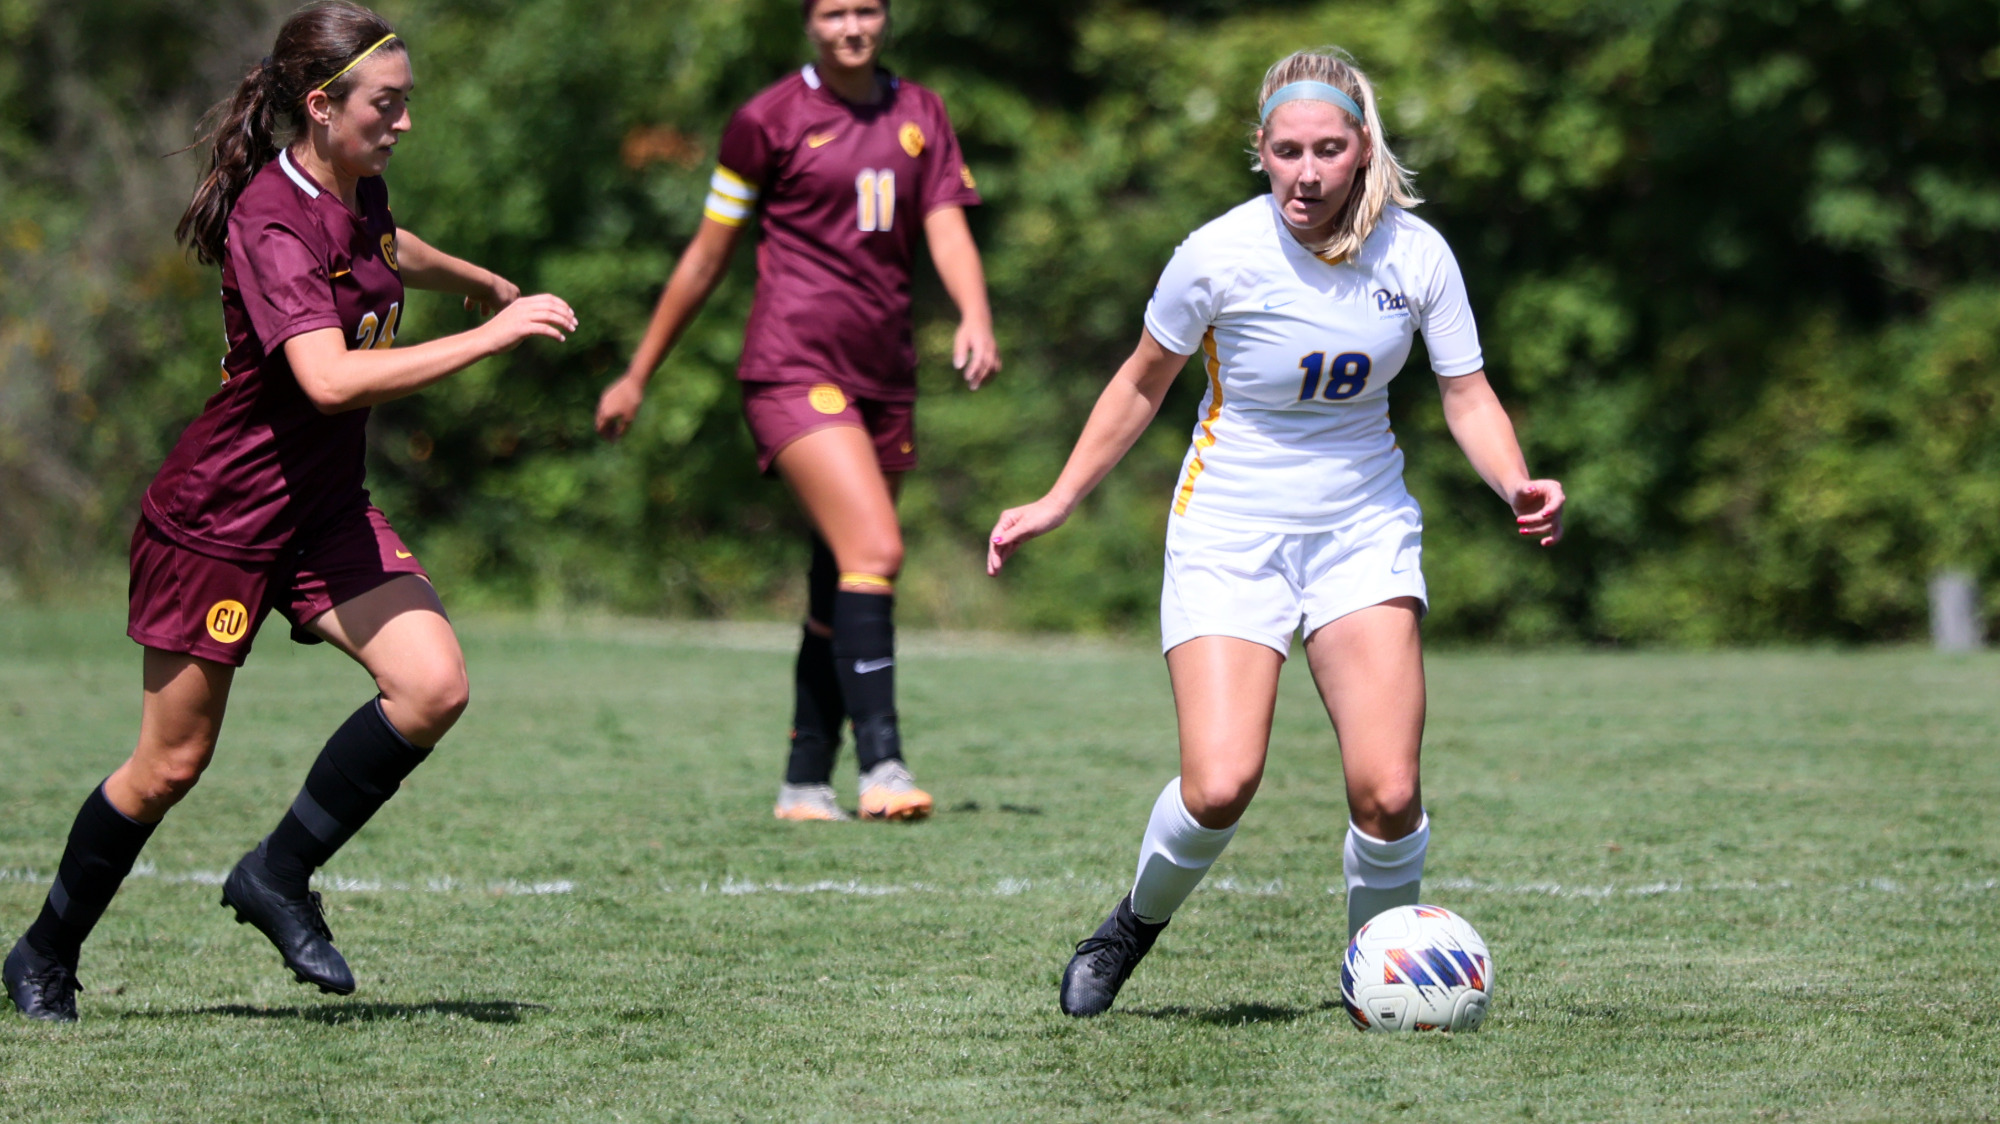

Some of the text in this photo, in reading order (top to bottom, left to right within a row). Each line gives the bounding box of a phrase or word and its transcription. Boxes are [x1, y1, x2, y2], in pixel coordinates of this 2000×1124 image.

[856, 168, 895, 231] 11
[1372, 288, 1407, 311] Pitt
[1298, 351, 1372, 401] 18
[213, 607, 243, 635] GU
